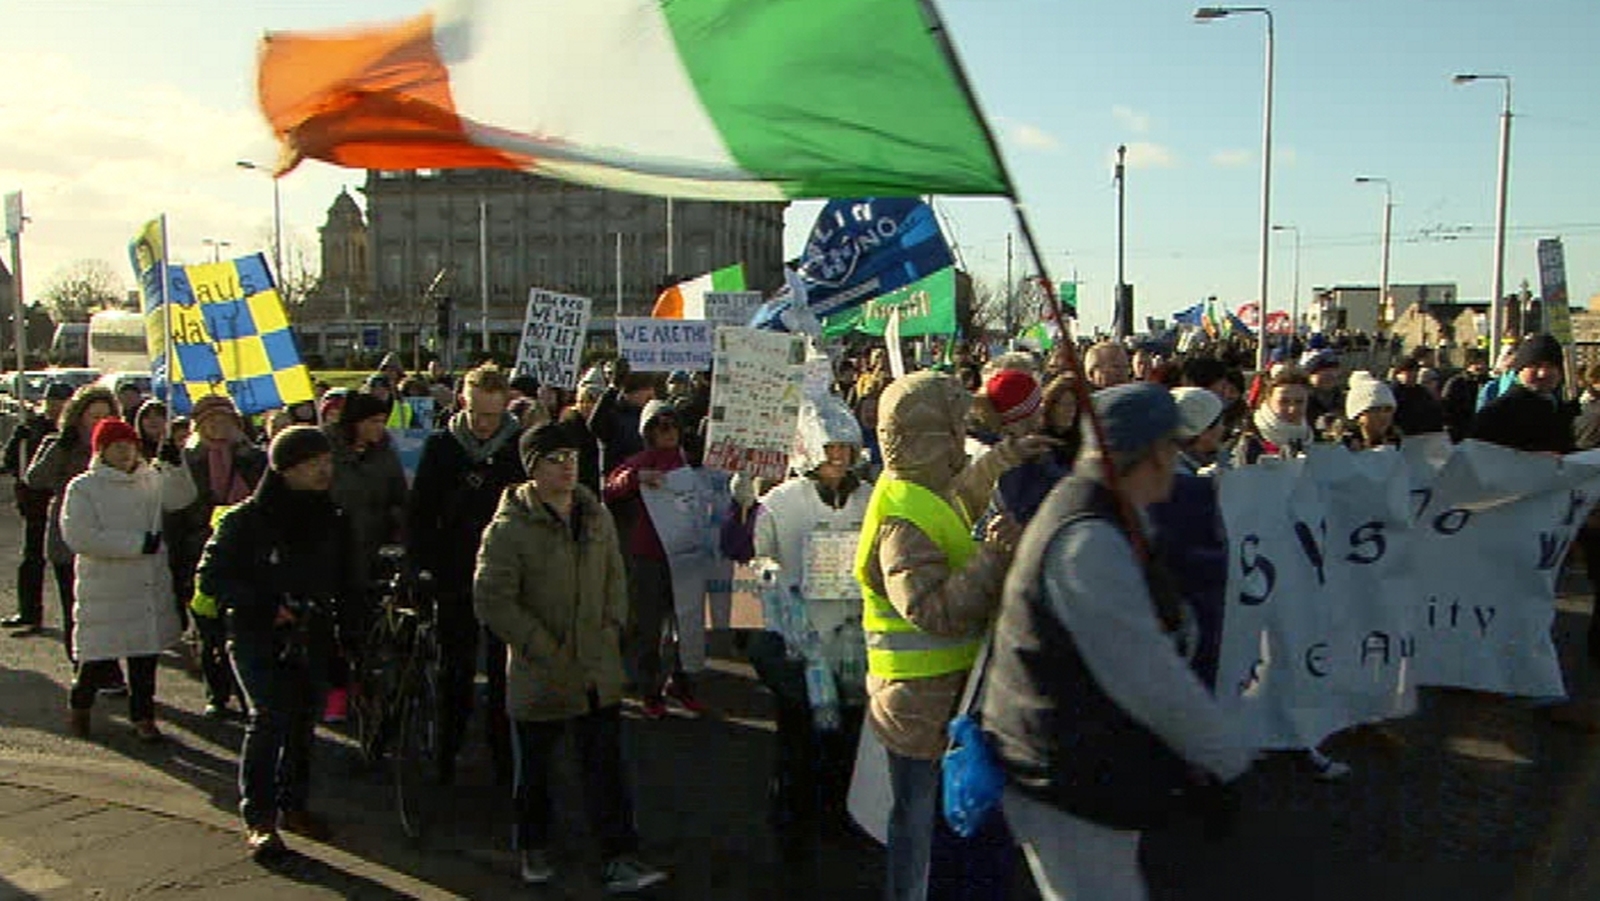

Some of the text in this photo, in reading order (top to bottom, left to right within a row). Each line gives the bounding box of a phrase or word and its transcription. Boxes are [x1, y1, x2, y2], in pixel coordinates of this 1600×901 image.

[531, 304, 582, 327] WE WILL
[527, 322, 581, 346] NOT LET
[620, 325, 650, 343] WE
[651, 325, 681, 344] ARE
